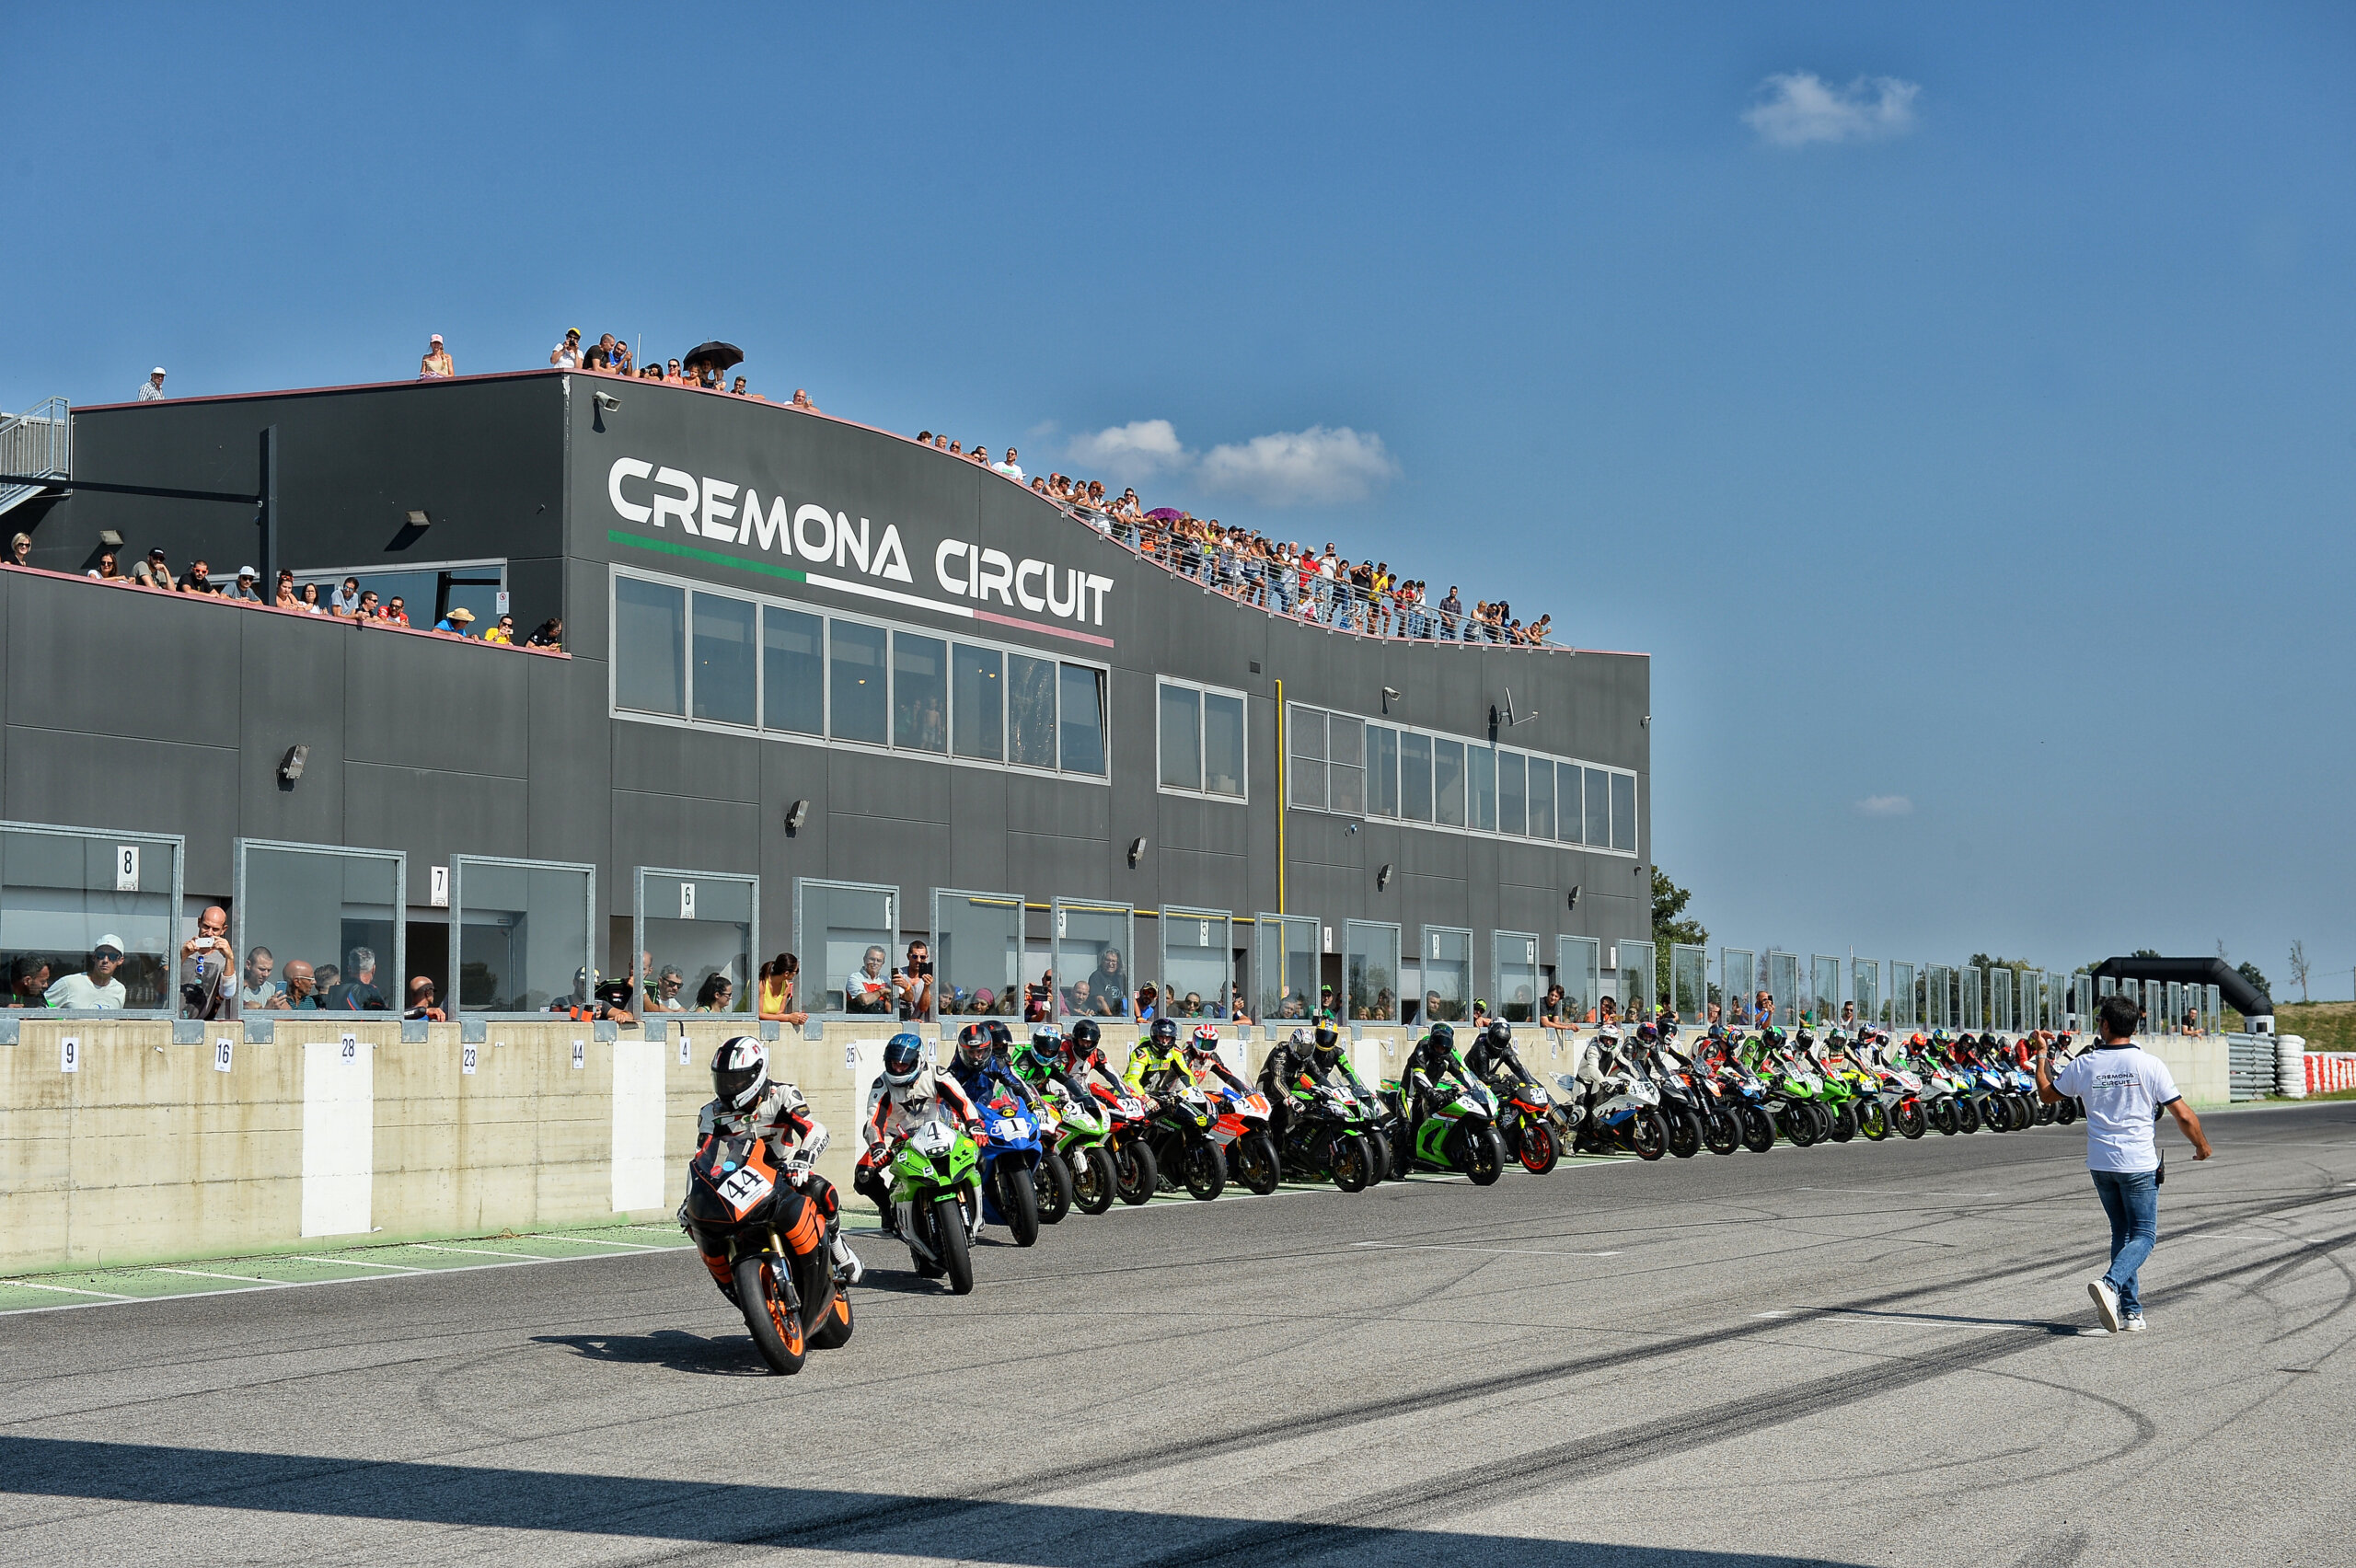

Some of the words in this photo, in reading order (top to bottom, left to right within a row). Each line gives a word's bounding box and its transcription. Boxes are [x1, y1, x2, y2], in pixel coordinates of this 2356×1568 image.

[607, 456, 913, 583] CREMONA
[935, 538, 1114, 627] CIRCUIT
[124, 850, 132, 874] 8
[436, 870, 443, 891] 7
[685, 886, 690, 905] 6
[1202, 919, 1207, 937] 5
[66, 1043, 75, 1064] 9
[217, 1043, 230, 1064] 16
[342, 1039, 355, 1057] 28
[682, 1042, 687, 1058] 4
[847, 1047, 855, 1063] 25
[929, 1042, 937, 1056] 21
[464, 1049, 476, 1067] 23
[1192, 1087, 1203, 1098] 8
[1067, 1101, 1086, 1115] 21
[1122, 1100, 1139, 1112] 29
[1462, 1099, 1474, 1109] 3
[928, 1122, 941, 1140] 4
[1011, 1119, 1022, 1132] 1
[727, 1169, 764, 1199] 44
